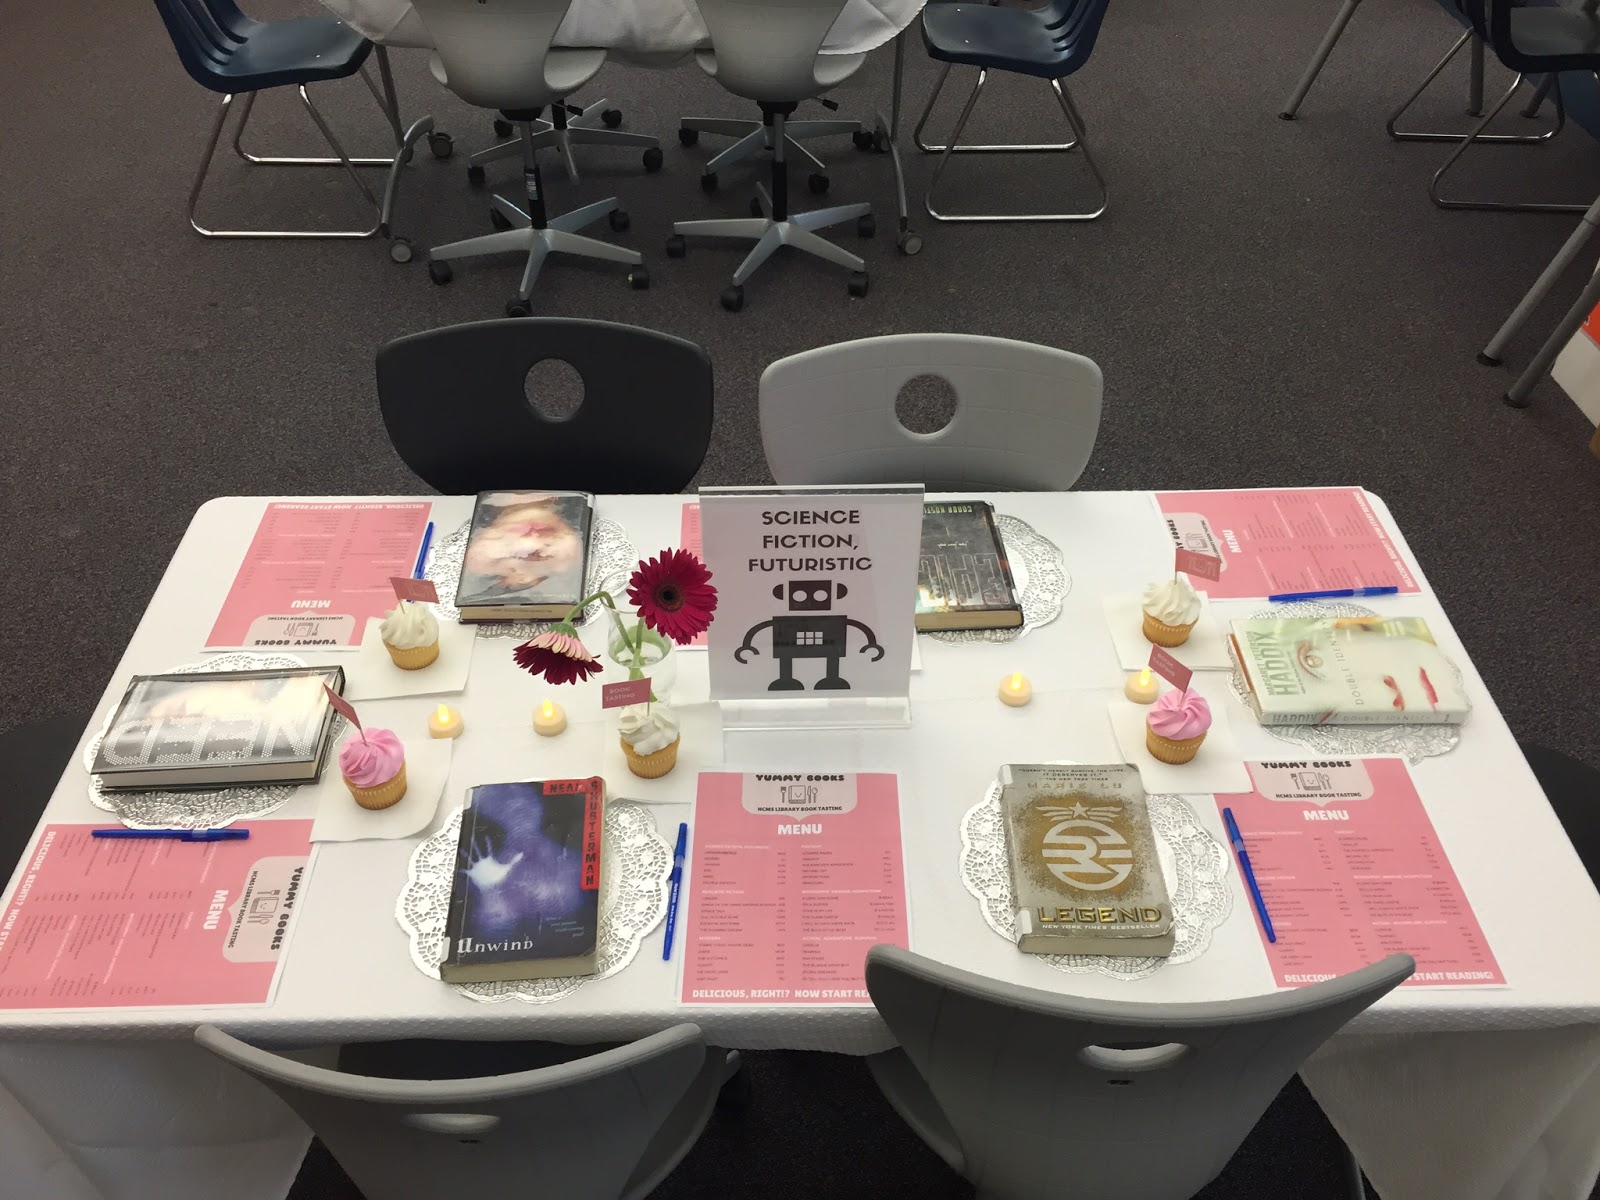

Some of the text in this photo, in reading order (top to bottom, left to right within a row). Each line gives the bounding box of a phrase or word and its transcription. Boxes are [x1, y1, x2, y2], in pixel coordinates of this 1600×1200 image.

[762, 510, 860, 525] SCIENCE
[1167, 520, 1180, 540] BOOKS
[762, 534, 858, 550] FICTION,
[1222, 530, 1242, 553] MENU
[748, 557, 872, 572] FUTURISTIC
[290, 600, 331, 608] MENU
[1245, 631, 1276, 696] MARGARET PETERSON
[1252, 631, 1300, 696] HADDIX
[609, 686, 631, 694] BOOK
[1342, 668, 1364, 705] DOUBLE
[606, 693, 635, 701] TASTING
[1272, 714, 1316, 724] HADDIX
[756, 774, 845, 782] YUMMY BOOKS
[1303, 810, 1350, 820] MENU
[777, 824, 822, 835] MENU
[0, 831, 56, 952] DELICIOUS, RIGHT!? NOW STA
[242, 886, 253, 908] LIBRARY
[203, 889, 229, 930] MENU
[270, 867, 304, 950] YUMMY BOOKS
[1037, 906, 1162, 923] LEGEND
[236, 909, 245, 924] BOOK
[228, 925, 240, 948] TASTING
[1446, 972, 1494, 980] READING!
[693, 990, 749, 999] DELICIOUS,
[751, 990, 790, 998] RIGHT!?
[794, 990, 820, 998] NOW
[822, 990, 852, 998] START
